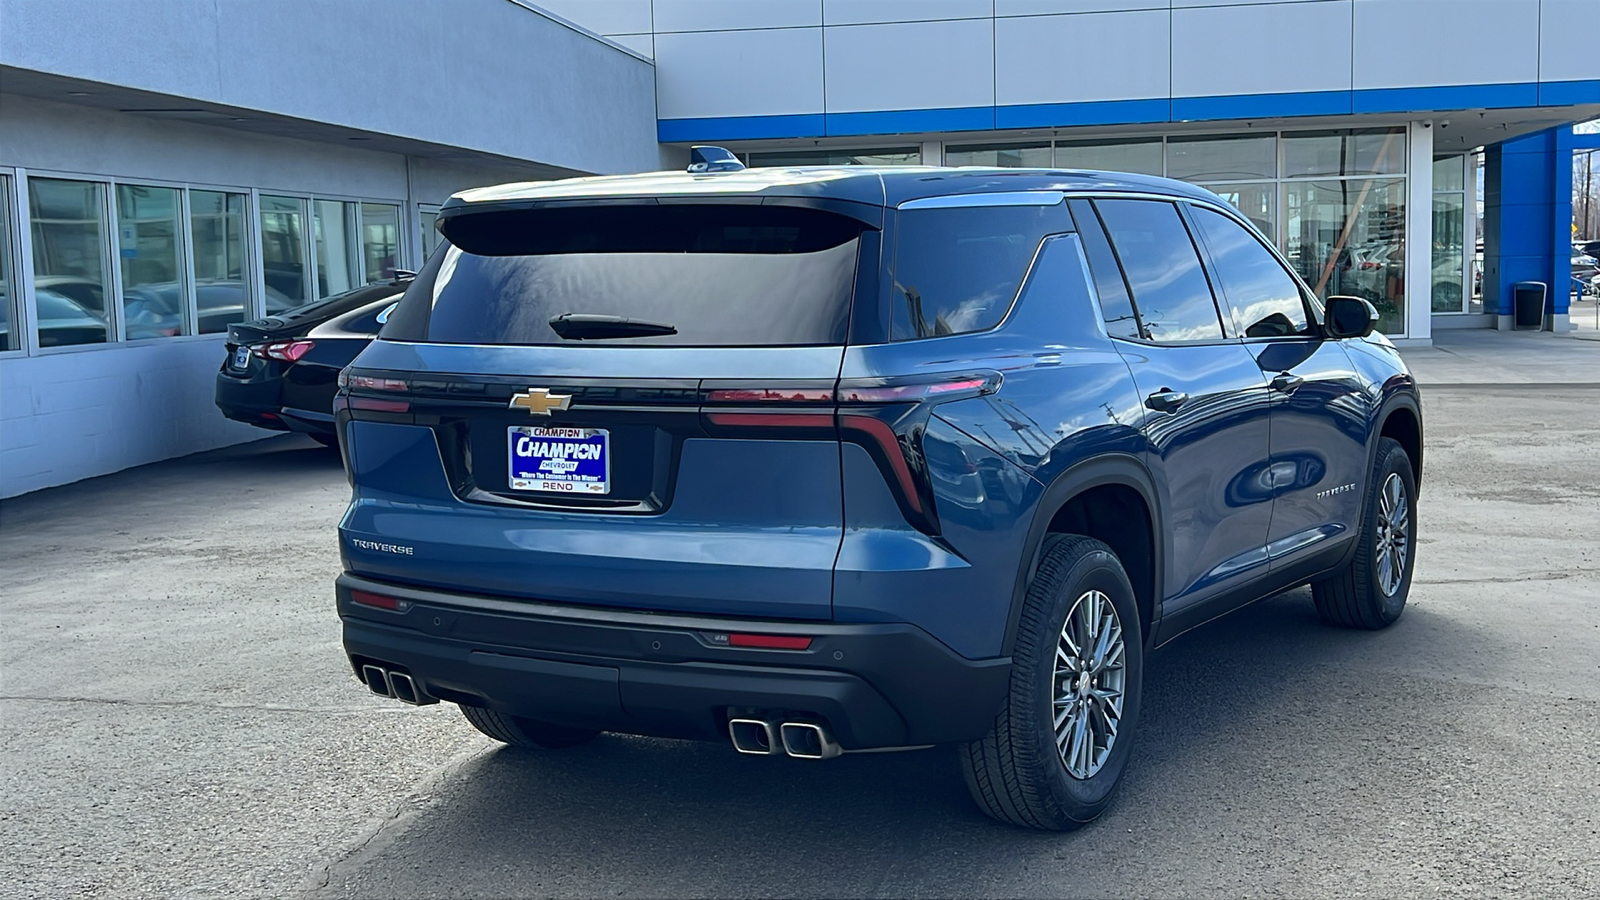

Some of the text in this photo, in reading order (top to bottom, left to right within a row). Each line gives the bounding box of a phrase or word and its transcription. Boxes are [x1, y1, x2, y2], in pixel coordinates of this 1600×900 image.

[534, 428, 580, 437] CHAMPION
[516, 437, 602, 460] CHAMPION
[542, 461, 576, 470] CHEVROLET
[536, 472, 545, 480] The
[542, 482, 574, 491] RENO
[353, 539, 414, 556] TRAVERSE
